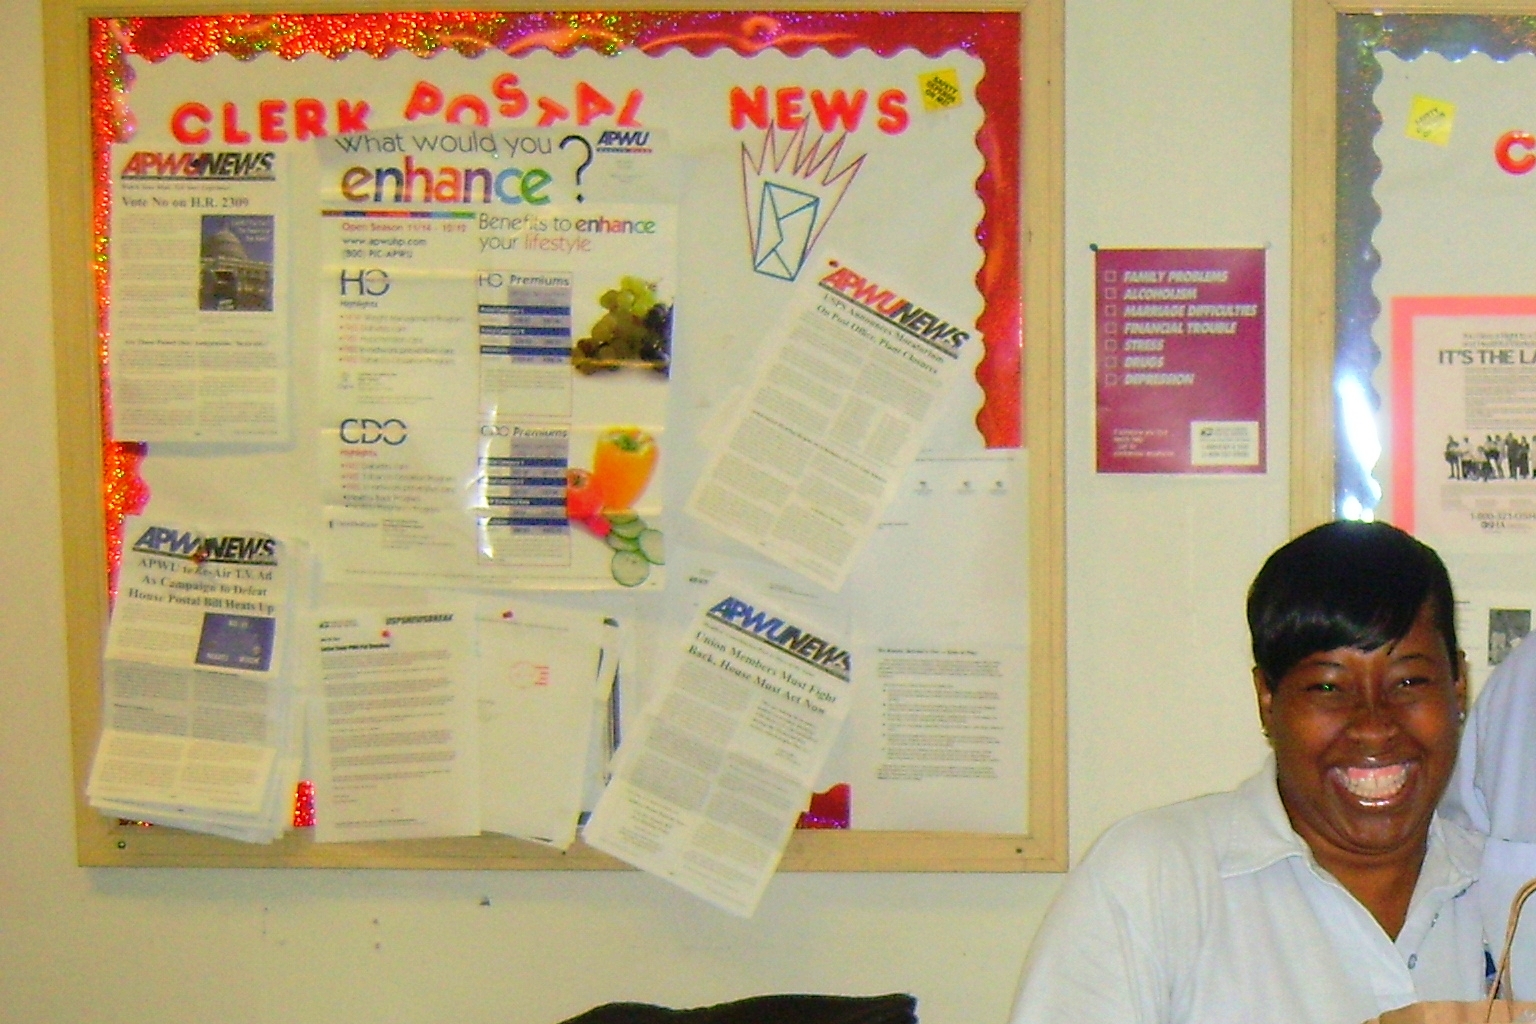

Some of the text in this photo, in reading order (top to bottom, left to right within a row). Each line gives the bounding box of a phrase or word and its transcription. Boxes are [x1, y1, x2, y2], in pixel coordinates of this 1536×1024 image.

[170, 72, 911, 145] CLERK POSTAL NEWS
[334, 132, 404, 152] What
[412, 132, 496, 152] would
[503, 137, 552, 157] you
[597, 131, 651, 147] APWU
[200, 151, 276, 176] NEWS
[341, 155, 553, 205] enhance
[121, 196, 249, 208] Vote No on H.R. 2309
[479, 212, 656, 234] Benefits to enhance
[479, 234, 591, 254] your lifestyle
[510, 274, 569, 286] Premiums
[821, 267, 970, 348] APWU NEWS
[1439, 349, 1473, 365] IT'S
[1479, 349, 1515, 365] THE
[203, 536, 278, 559] NEWS
[160, 576, 215, 593] Campaign
[221, 585, 230, 593] to
[169, 594, 199, 605] Postal
[709, 596, 788, 643] APWU
[731, 646, 777, 676] Members
[806, 699, 826, 715] Now
